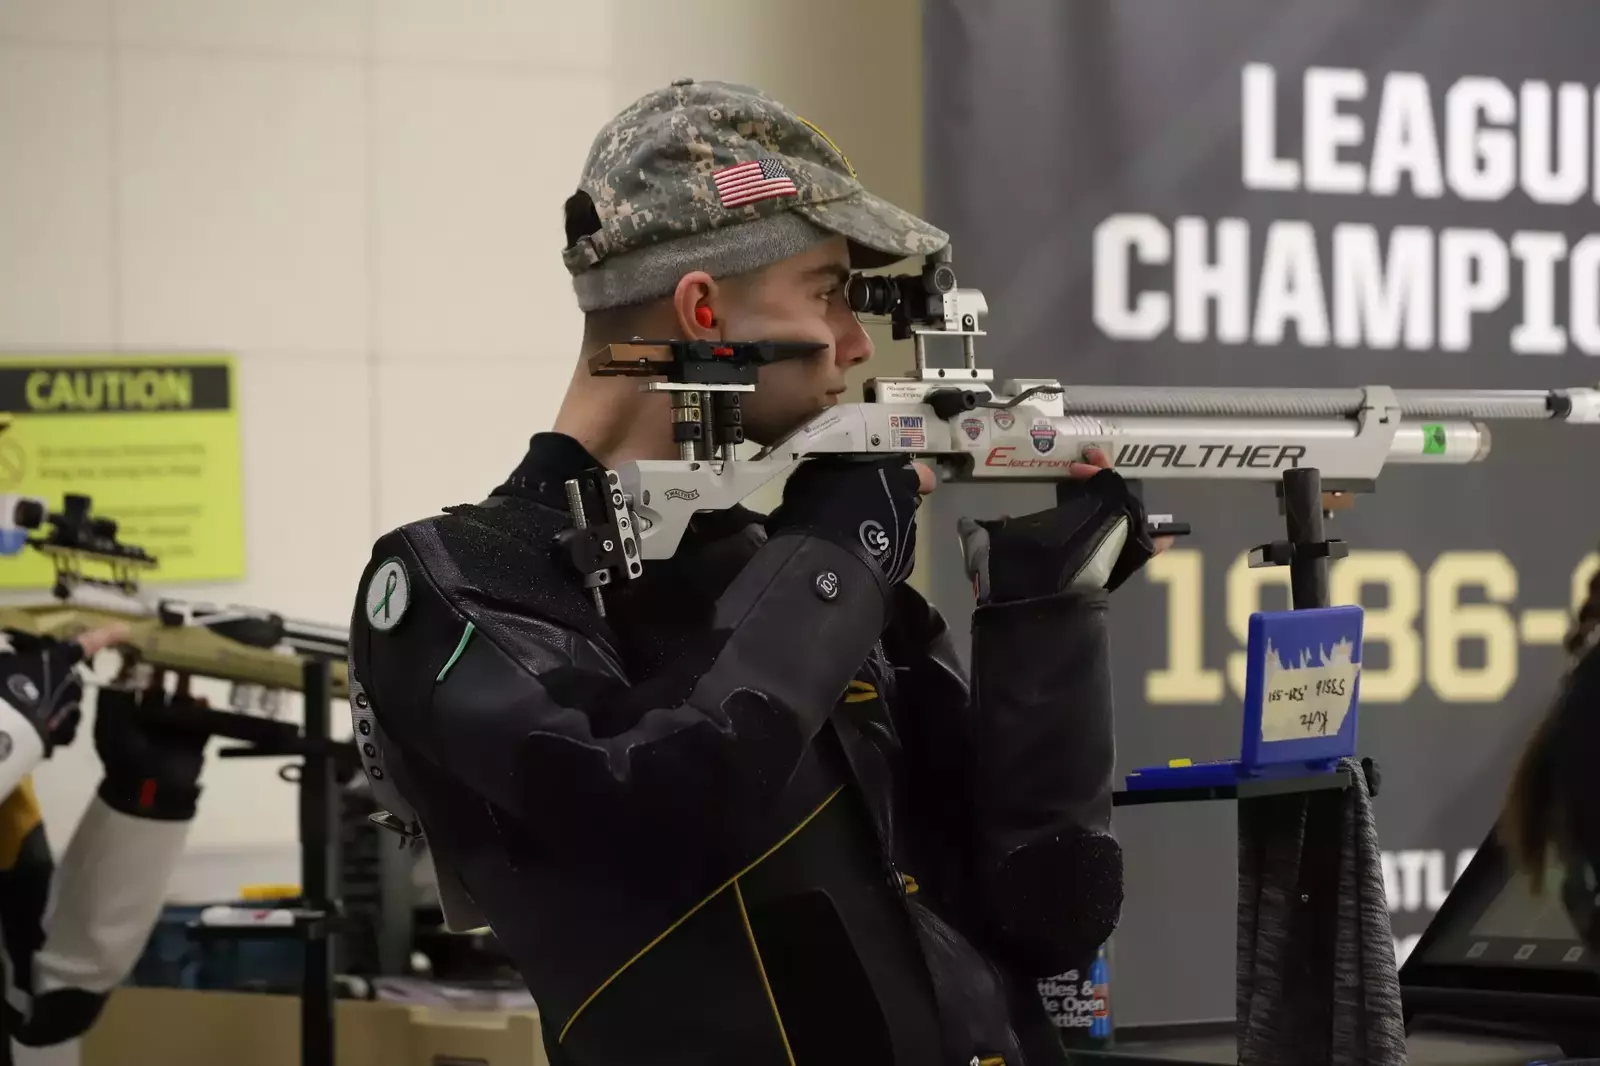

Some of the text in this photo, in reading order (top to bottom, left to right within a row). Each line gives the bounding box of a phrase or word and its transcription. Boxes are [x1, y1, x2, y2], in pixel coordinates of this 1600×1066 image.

[1241, 62, 1600, 205] LEAGU
[25, 370, 192, 411] CAUTION
[899, 416, 923, 428] TWENTY
[1114, 444, 1307, 468] WALTHER
[1063, 997, 1104, 1014] Open
